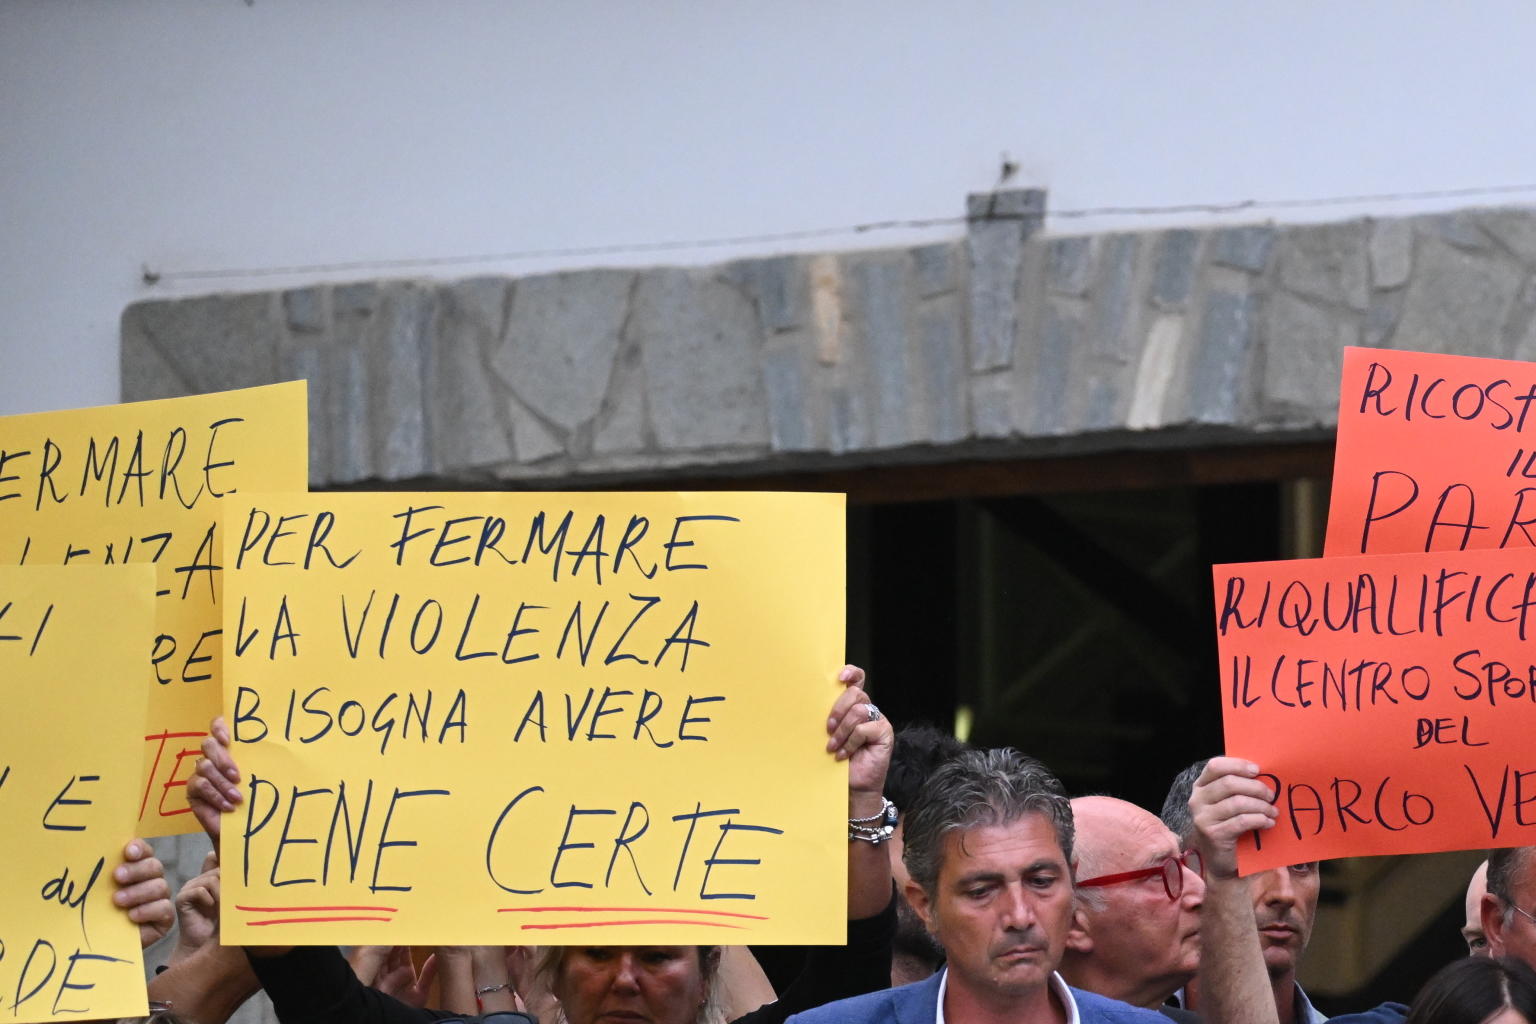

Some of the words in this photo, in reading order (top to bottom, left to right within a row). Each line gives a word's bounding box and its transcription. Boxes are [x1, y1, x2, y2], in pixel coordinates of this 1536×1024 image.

[233, 506, 363, 571] PER
[391, 505, 740, 585] FERMARE
[235, 594, 302, 661] LA
[341, 590, 712, 671] VIOLENZA
[232, 685, 468, 755] BISOGNA
[513, 689, 727, 749] AVERE
[1270, 656, 1430, 711] CENTRO
[1413, 716, 1490, 749] DEL
[240, 774, 451, 894] PENE
[486, 785, 785, 901] CERTE
[1253, 772, 1435, 851] PARCO
[40, 855, 105, 952] del
